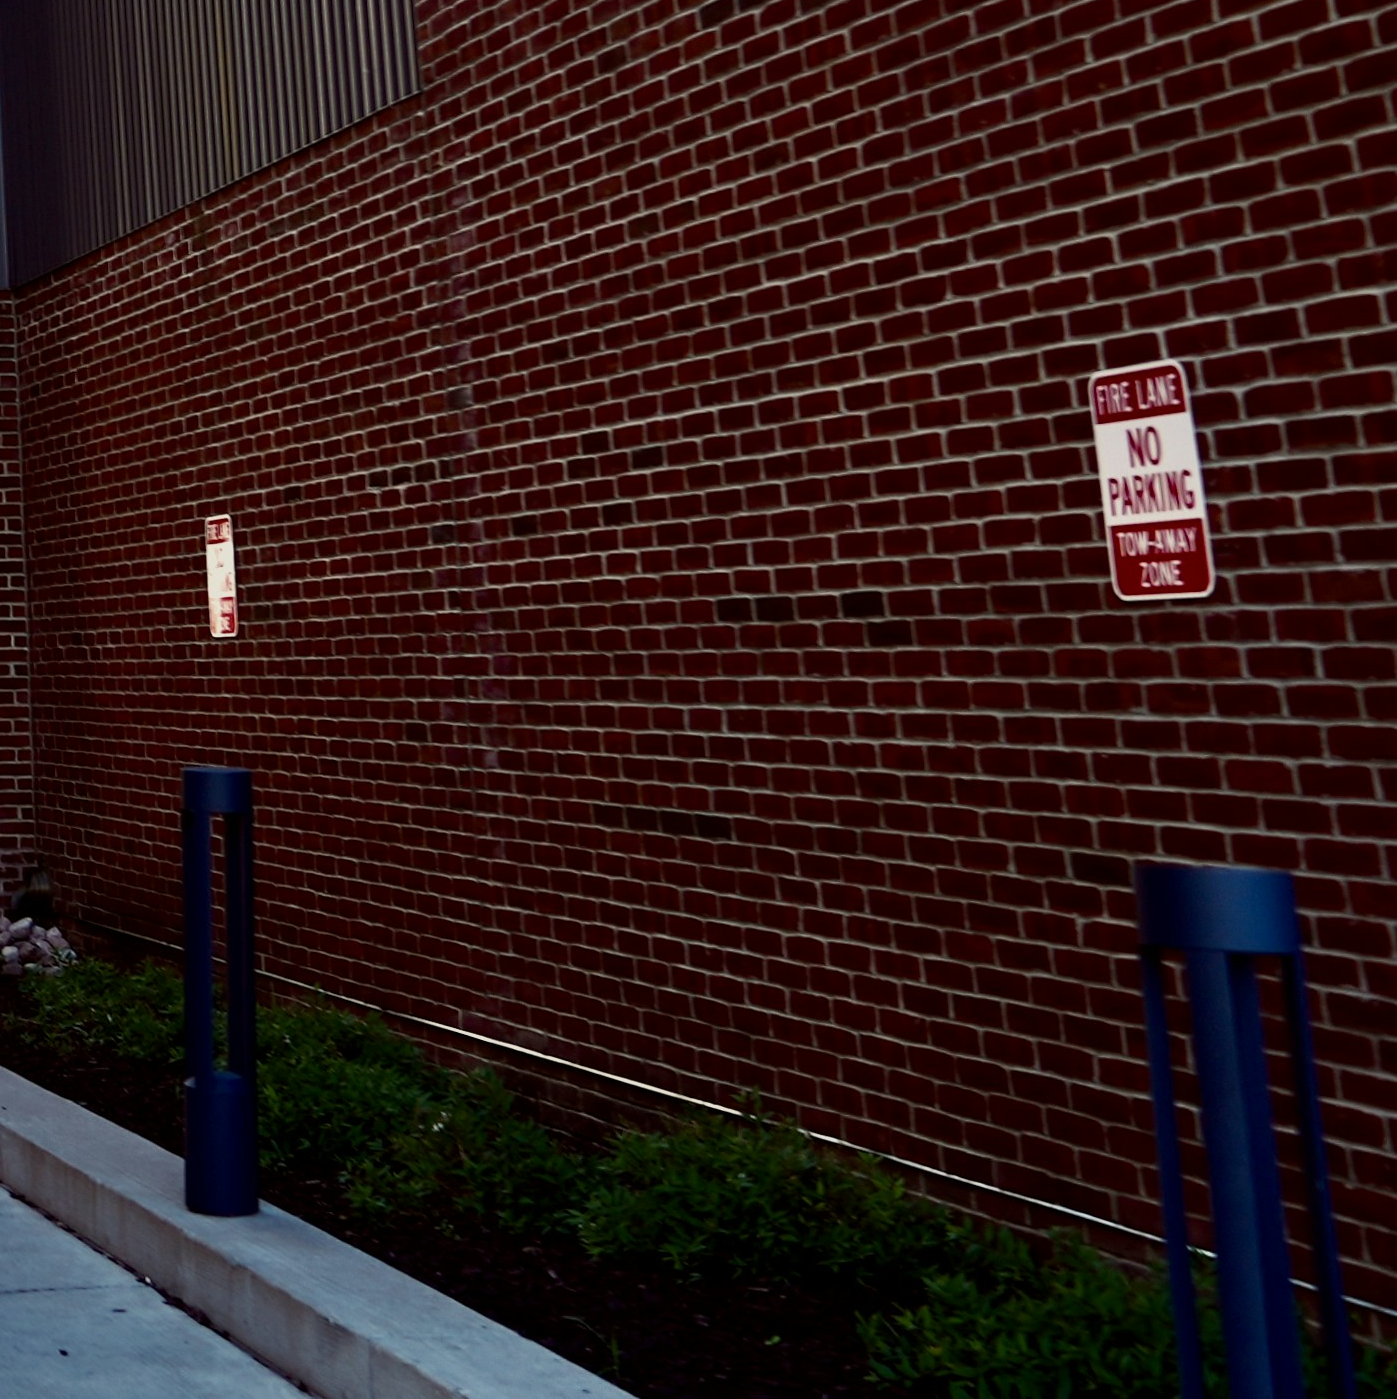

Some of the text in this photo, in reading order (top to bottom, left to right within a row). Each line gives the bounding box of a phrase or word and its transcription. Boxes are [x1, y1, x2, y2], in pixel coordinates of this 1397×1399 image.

[1095, 373, 1181, 415] FIRE LANE
[1125, 426, 1162, 468] NO
[1108, 469, 1195, 516] PARKING
[1116, 526, 1197, 557] TOW-AWAY
[1139, 559, 1185, 588] ZONE
